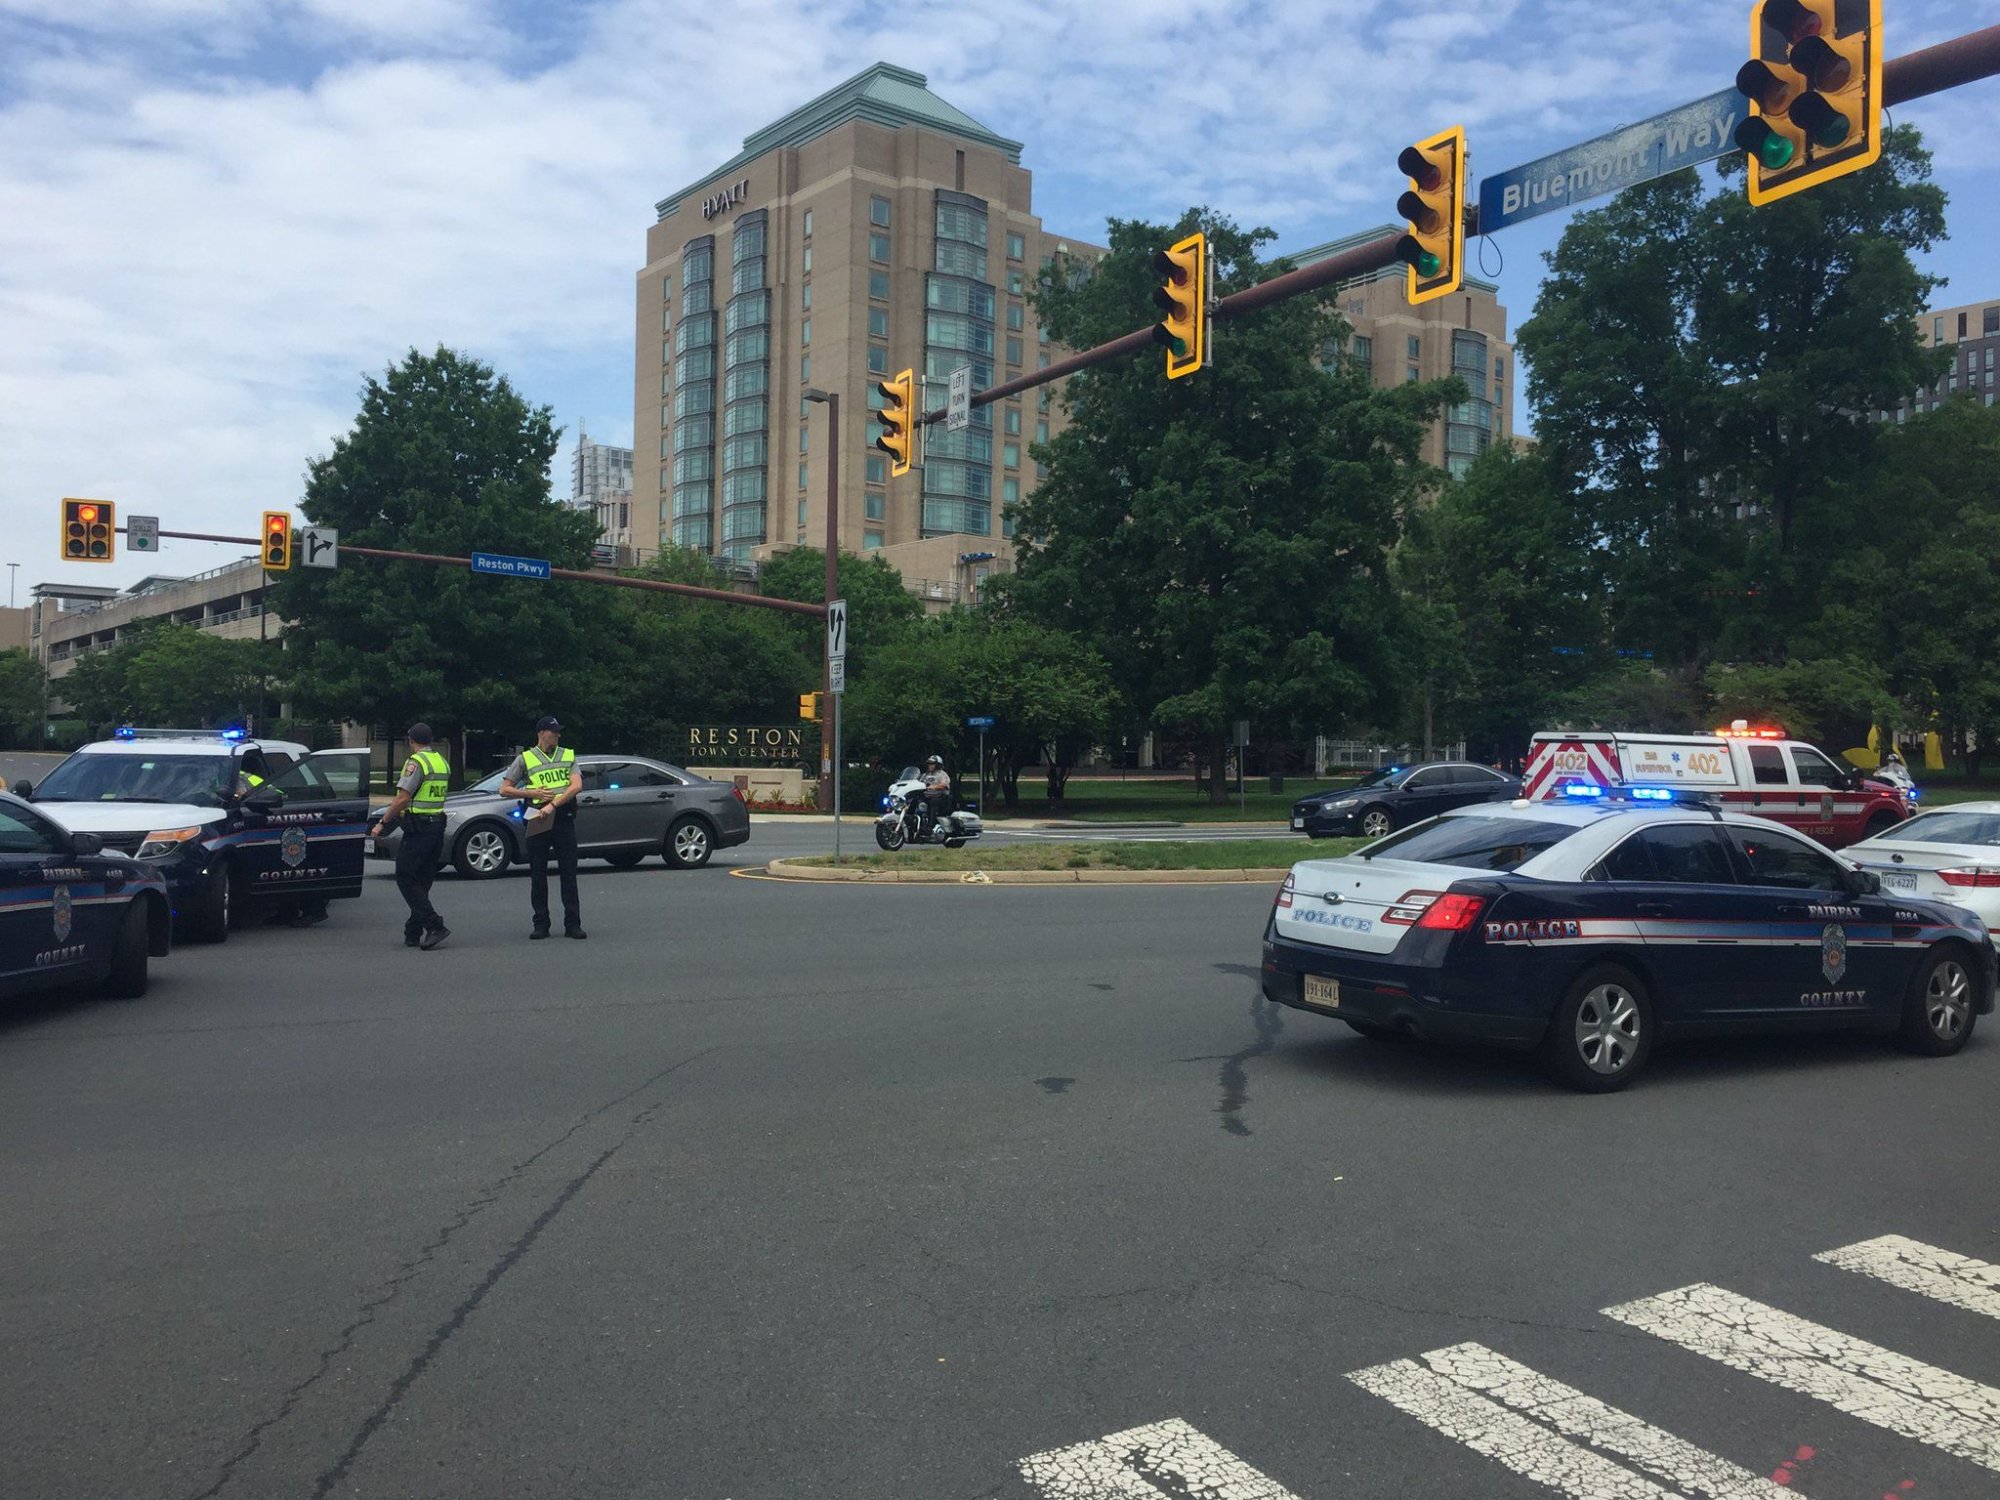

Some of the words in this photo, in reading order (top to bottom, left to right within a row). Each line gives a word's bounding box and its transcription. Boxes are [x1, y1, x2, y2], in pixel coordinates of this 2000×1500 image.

[1503, 148, 1649, 215] Bluemont
[1664, 112, 1736, 159] Way
[702, 179, 749, 218] HYATT
[478, 557, 514, 571] Reston
[517, 562, 544, 576] Pkwy
[690, 727, 802, 745] RESTON
[690, 747, 728, 757] TOWN
[738, 748, 800, 758] CENTER
[1555, 753, 1586, 770] 402
[1688, 752, 1722, 775] 402
[539, 768, 570, 785] POLICE
[266, 812, 325, 825] FAIRFAX
[259, 867, 329, 881] COUNTY
[1808, 905, 1862, 919] FAIRFAX
[1292, 909, 1373, 934] POLICE
[1486, 920, 1579, 941] POLICE
[34, 943, 85, 965] COUNTY
[1800, 990, 1866, 1006] COUNTY
